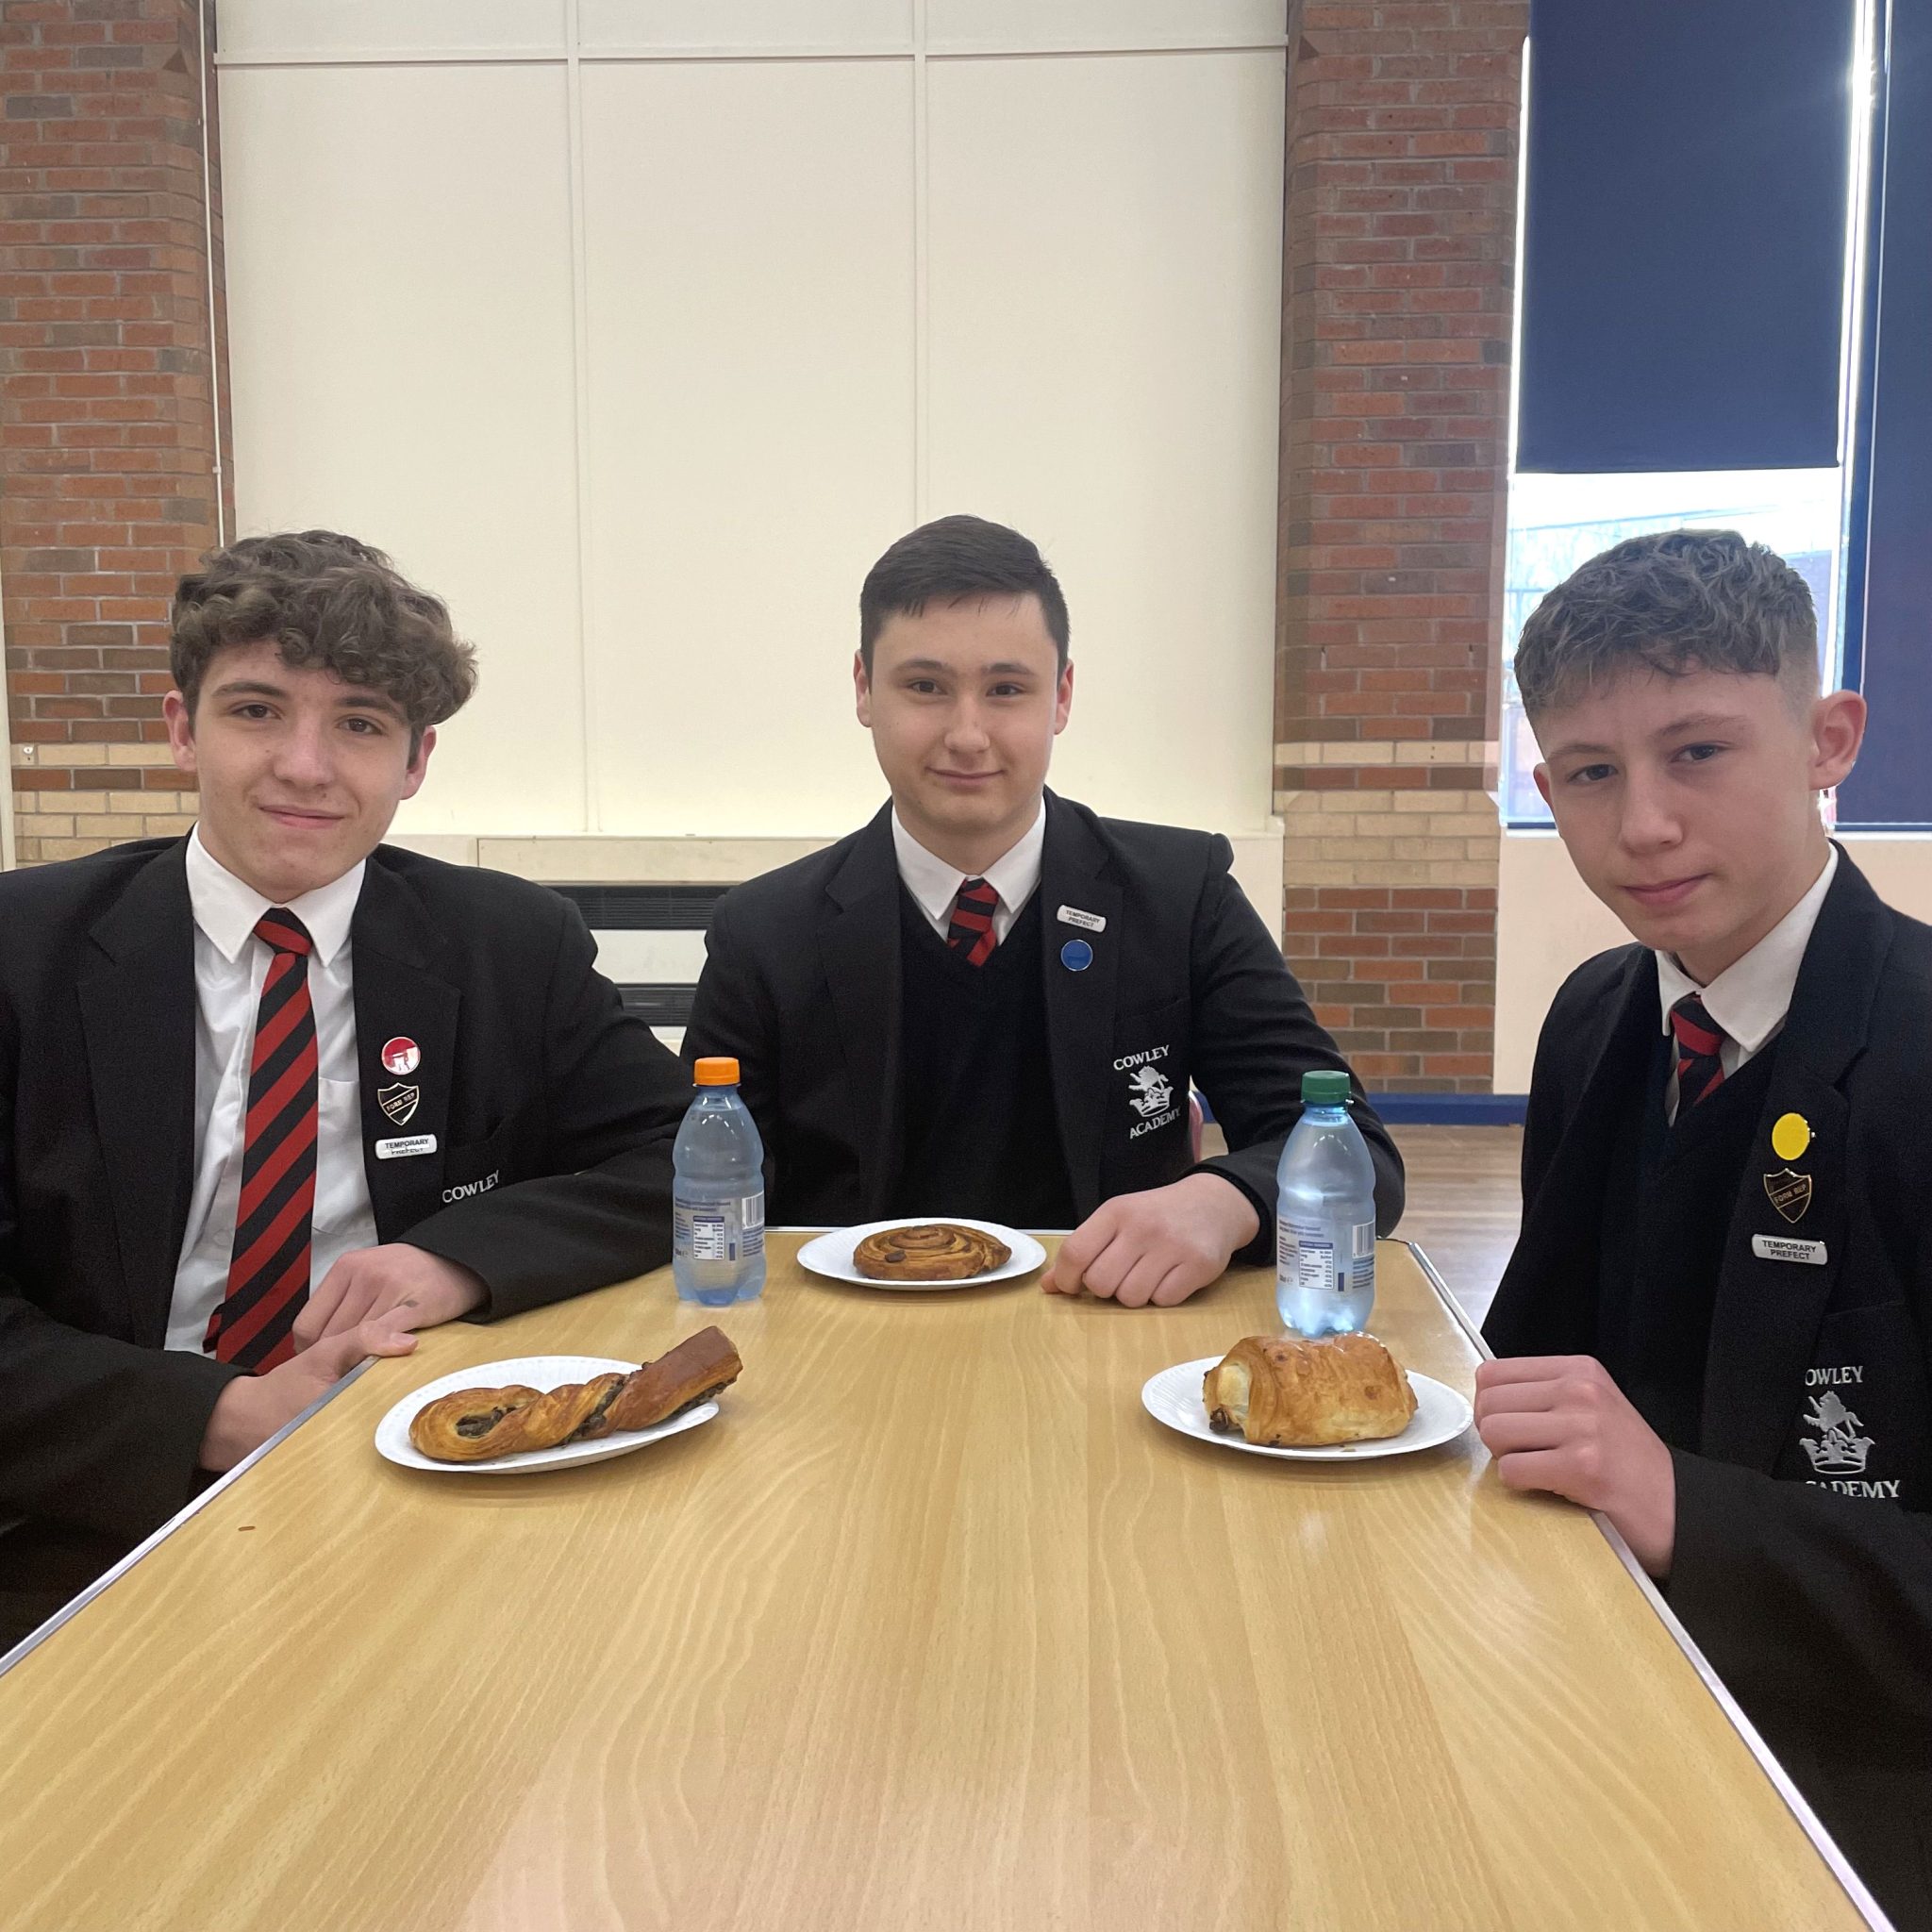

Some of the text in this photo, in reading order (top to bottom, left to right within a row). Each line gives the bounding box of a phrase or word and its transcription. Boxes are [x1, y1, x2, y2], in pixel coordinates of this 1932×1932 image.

[1066, 910, 1101, 924] TEMPORARY
[1068, 917, 1094, 926] PREFECT
[1113, 1044, 1170, 1071] COWLEY
[1130, 1106, 1181, 1140] ACADEMY
[385, 1139, 429, 1148] TEMPORARY
[441, 1169, 499, 1204] COWLEY
[1774, 1191, 1793, 1204] FORM
[1762, 1240, 1817, 1253] TEMPORARY
[1771, 1249, 1809, 1260] PREFECT
[1805, 1365, 1864, 1386] OWLEY
